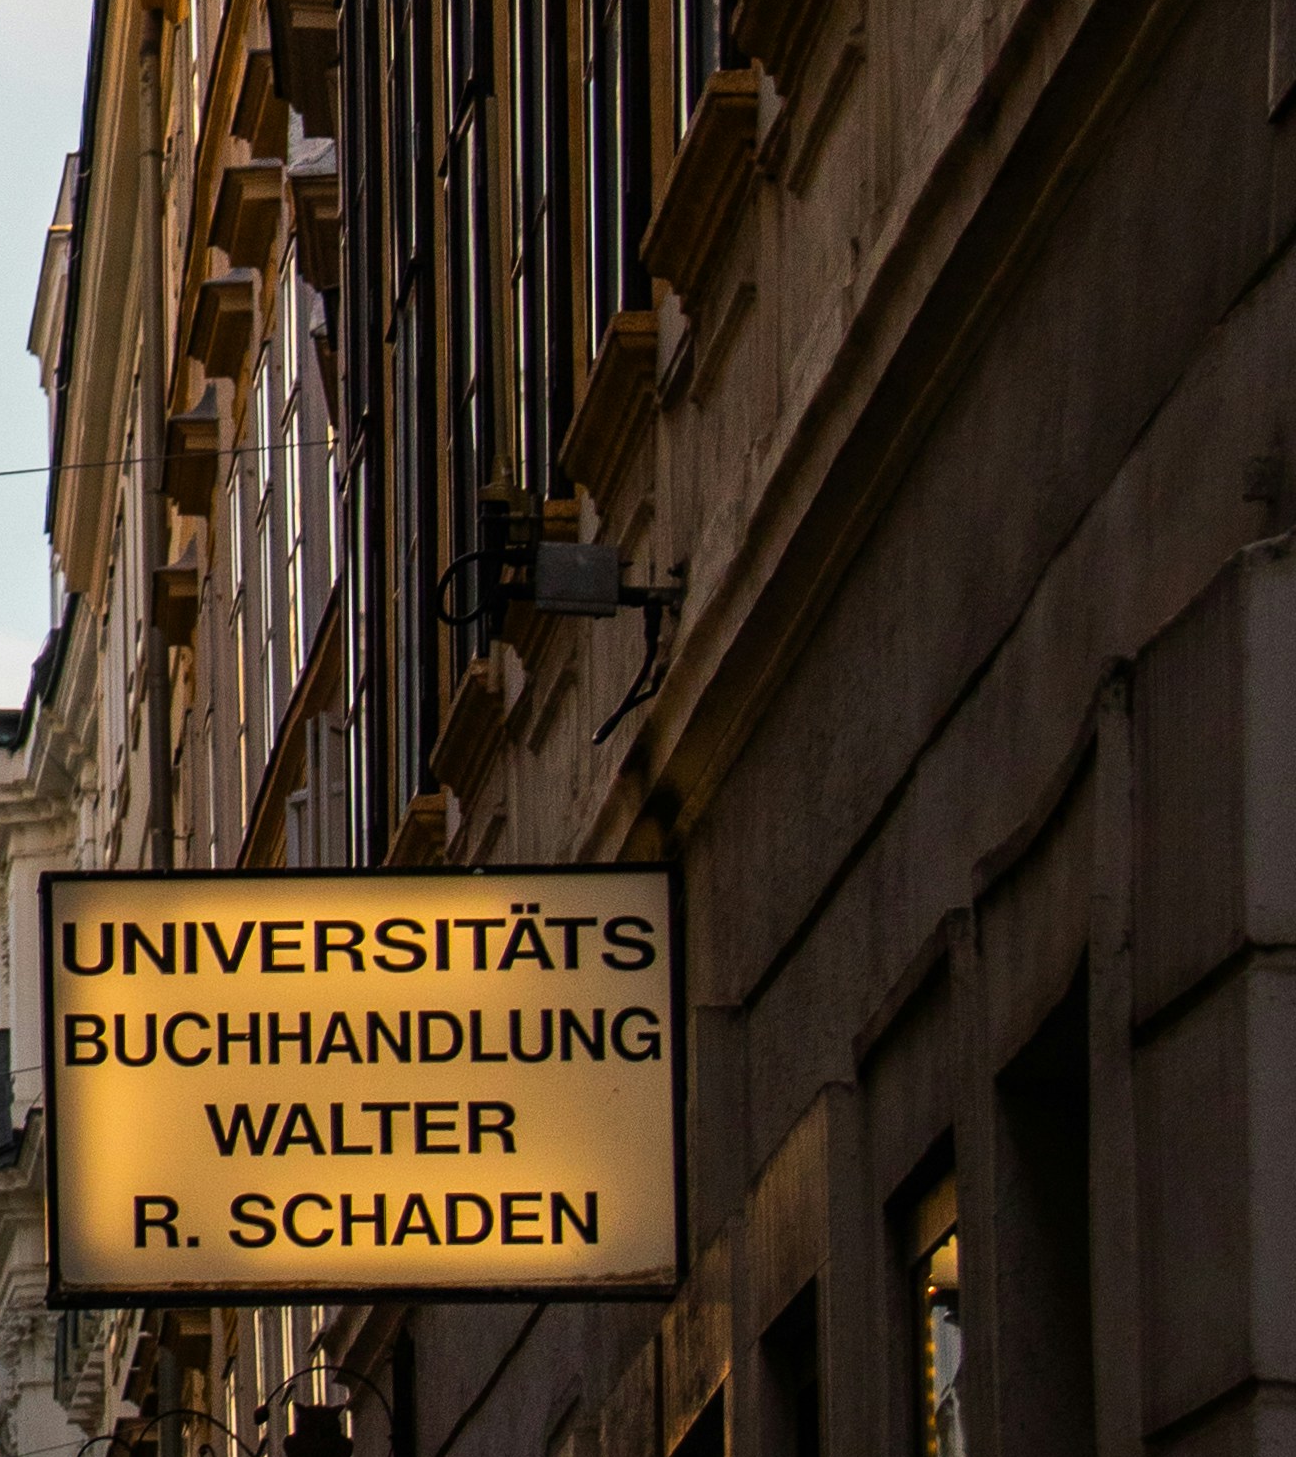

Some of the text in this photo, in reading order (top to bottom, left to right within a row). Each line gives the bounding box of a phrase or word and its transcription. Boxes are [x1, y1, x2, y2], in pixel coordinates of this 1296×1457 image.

[61, 903, 657, 976] UNIVERSITÄTS
[64, 1006, 662, 1067] BUCHHANDLUNG
[204, 1100, 518, 1157] WALTER
[133, 1191, 600, 1249] R. SCHADEN
